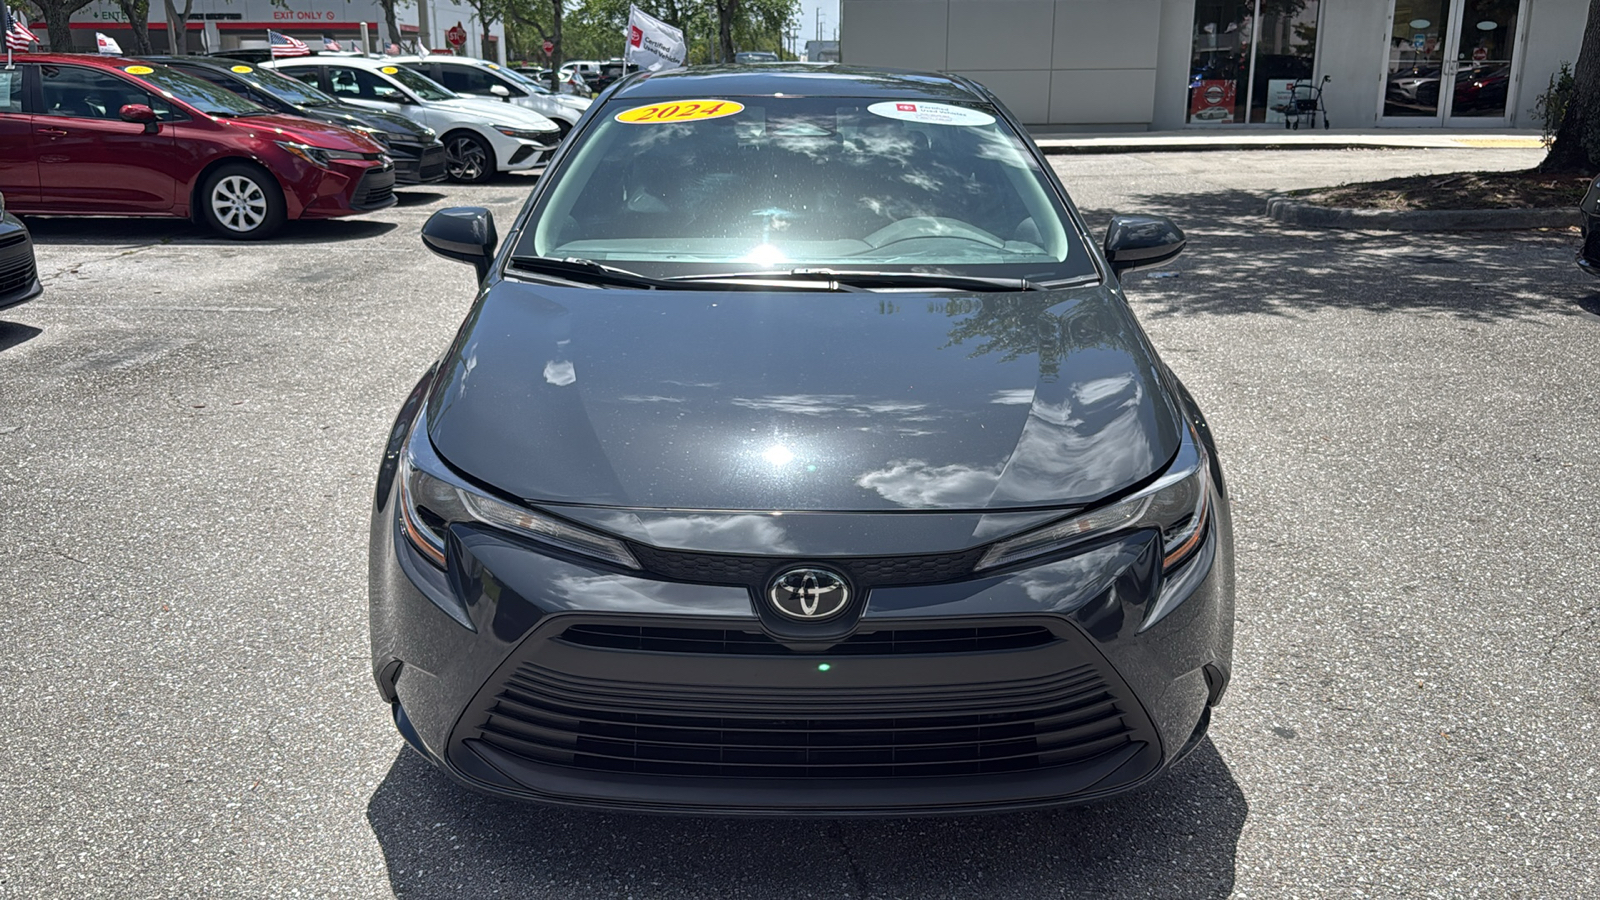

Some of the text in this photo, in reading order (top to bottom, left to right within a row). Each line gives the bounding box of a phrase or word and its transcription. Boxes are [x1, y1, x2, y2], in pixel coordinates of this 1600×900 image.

[102, 11, 128, 20] ENTE
[273, 11, 322, 20] EXIT ONLY
[643, 43, 658, 55] Used
[644, 36, 671, 53] Certified
[634, 102, 726, 121] 2024
